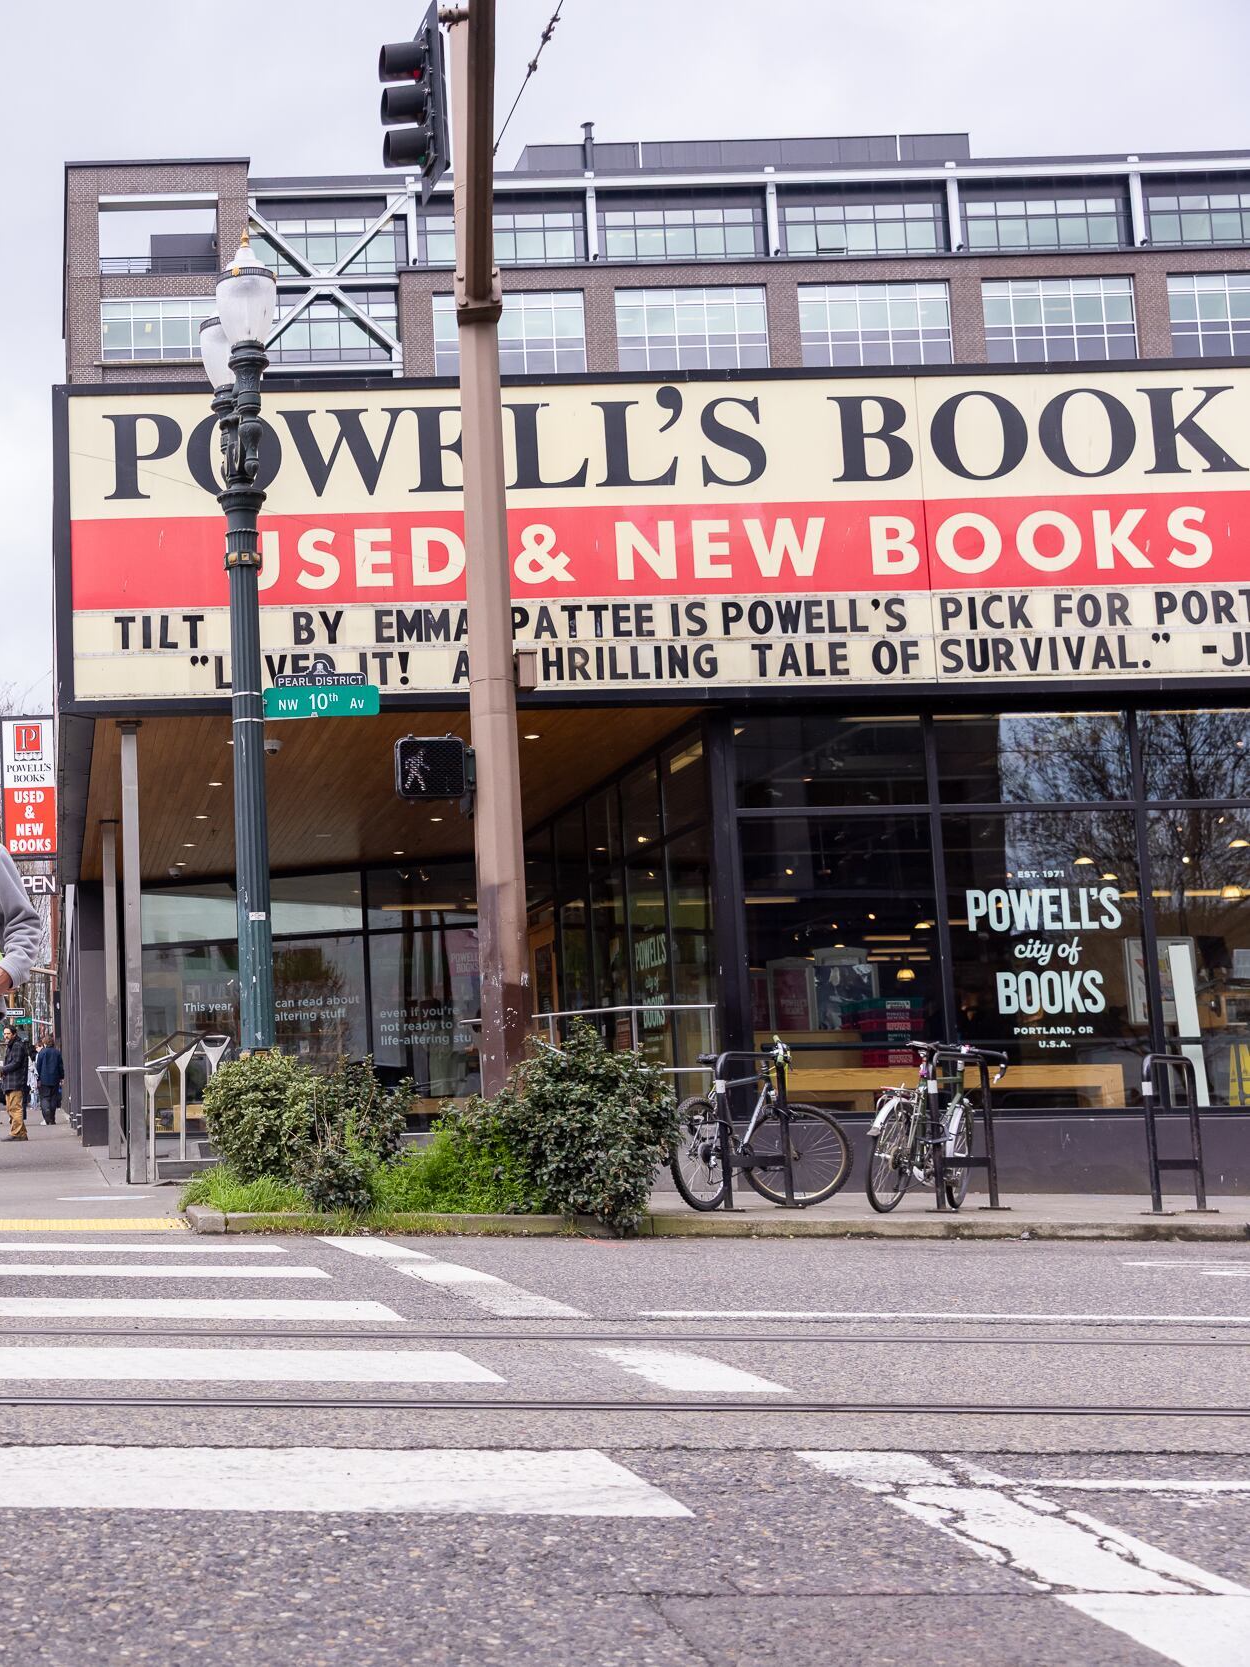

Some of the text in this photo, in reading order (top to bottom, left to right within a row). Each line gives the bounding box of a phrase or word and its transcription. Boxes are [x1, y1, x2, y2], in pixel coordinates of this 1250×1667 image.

[103, 386, 1250, 499] POWELL'S BOOK
[225, 506, 1213, 591] USED & NEW BOOKS
[114, 615, 204, 649] TILT
[293, 610, 344, 646] BY
[375, 608, 469, 643] EMMA
[512, 602, 655, 640] PATTEE
[671, 602, 709, 637] IS
[722, 599, 907, 636] POWELL'S
[940, 595, 1032, 631] PICK
[1054, 593, 1132, 628] FOR
[359, 651, 410, 686] IT!
[542, 643, 718, 681] HRILLING
[751, 642, 850, 677] TALE
[872, 641, 920, 675] OF
[278, 675, 363, 687] PEARL DISTRICT
[278, 699, 299, 710] NW
[309, 692, 339, 710] 10th
[6, 763, 52, 773] POWELL'S
[13, 774, 45, 783] BOOKS
[13, 790, 45, 804] USED
[24, 805, 35, 819] &
[15, 823, 44, 836] NEW
[9, 839, 52, 852] BOOKS
[1017, 870, 1065, 878] EST. 1971
[21, 875, 56, 893] PEN
[966, 886, 1122, 931] POWELL'S
[1014, 936, 1083, 966] city of
[996, 969, 1106, 1015] BOOKS
[184, 995, 360, 1013] This year, can read about
[274, 1008, 346, 1022] altering stuff
[380, 1006, 459, 1018] even if you're
[381, 1022, 399, 1032] not
[404, 1020, 437, 1032] ready
[442, 1021, 453, 1030] to
[1014, 1026, 1094, 1036] PORTLAND, OR
[381, 1033, 471, 1046] life-altering stu
[1038, 1040, 1071, 1048] U.S.A.
